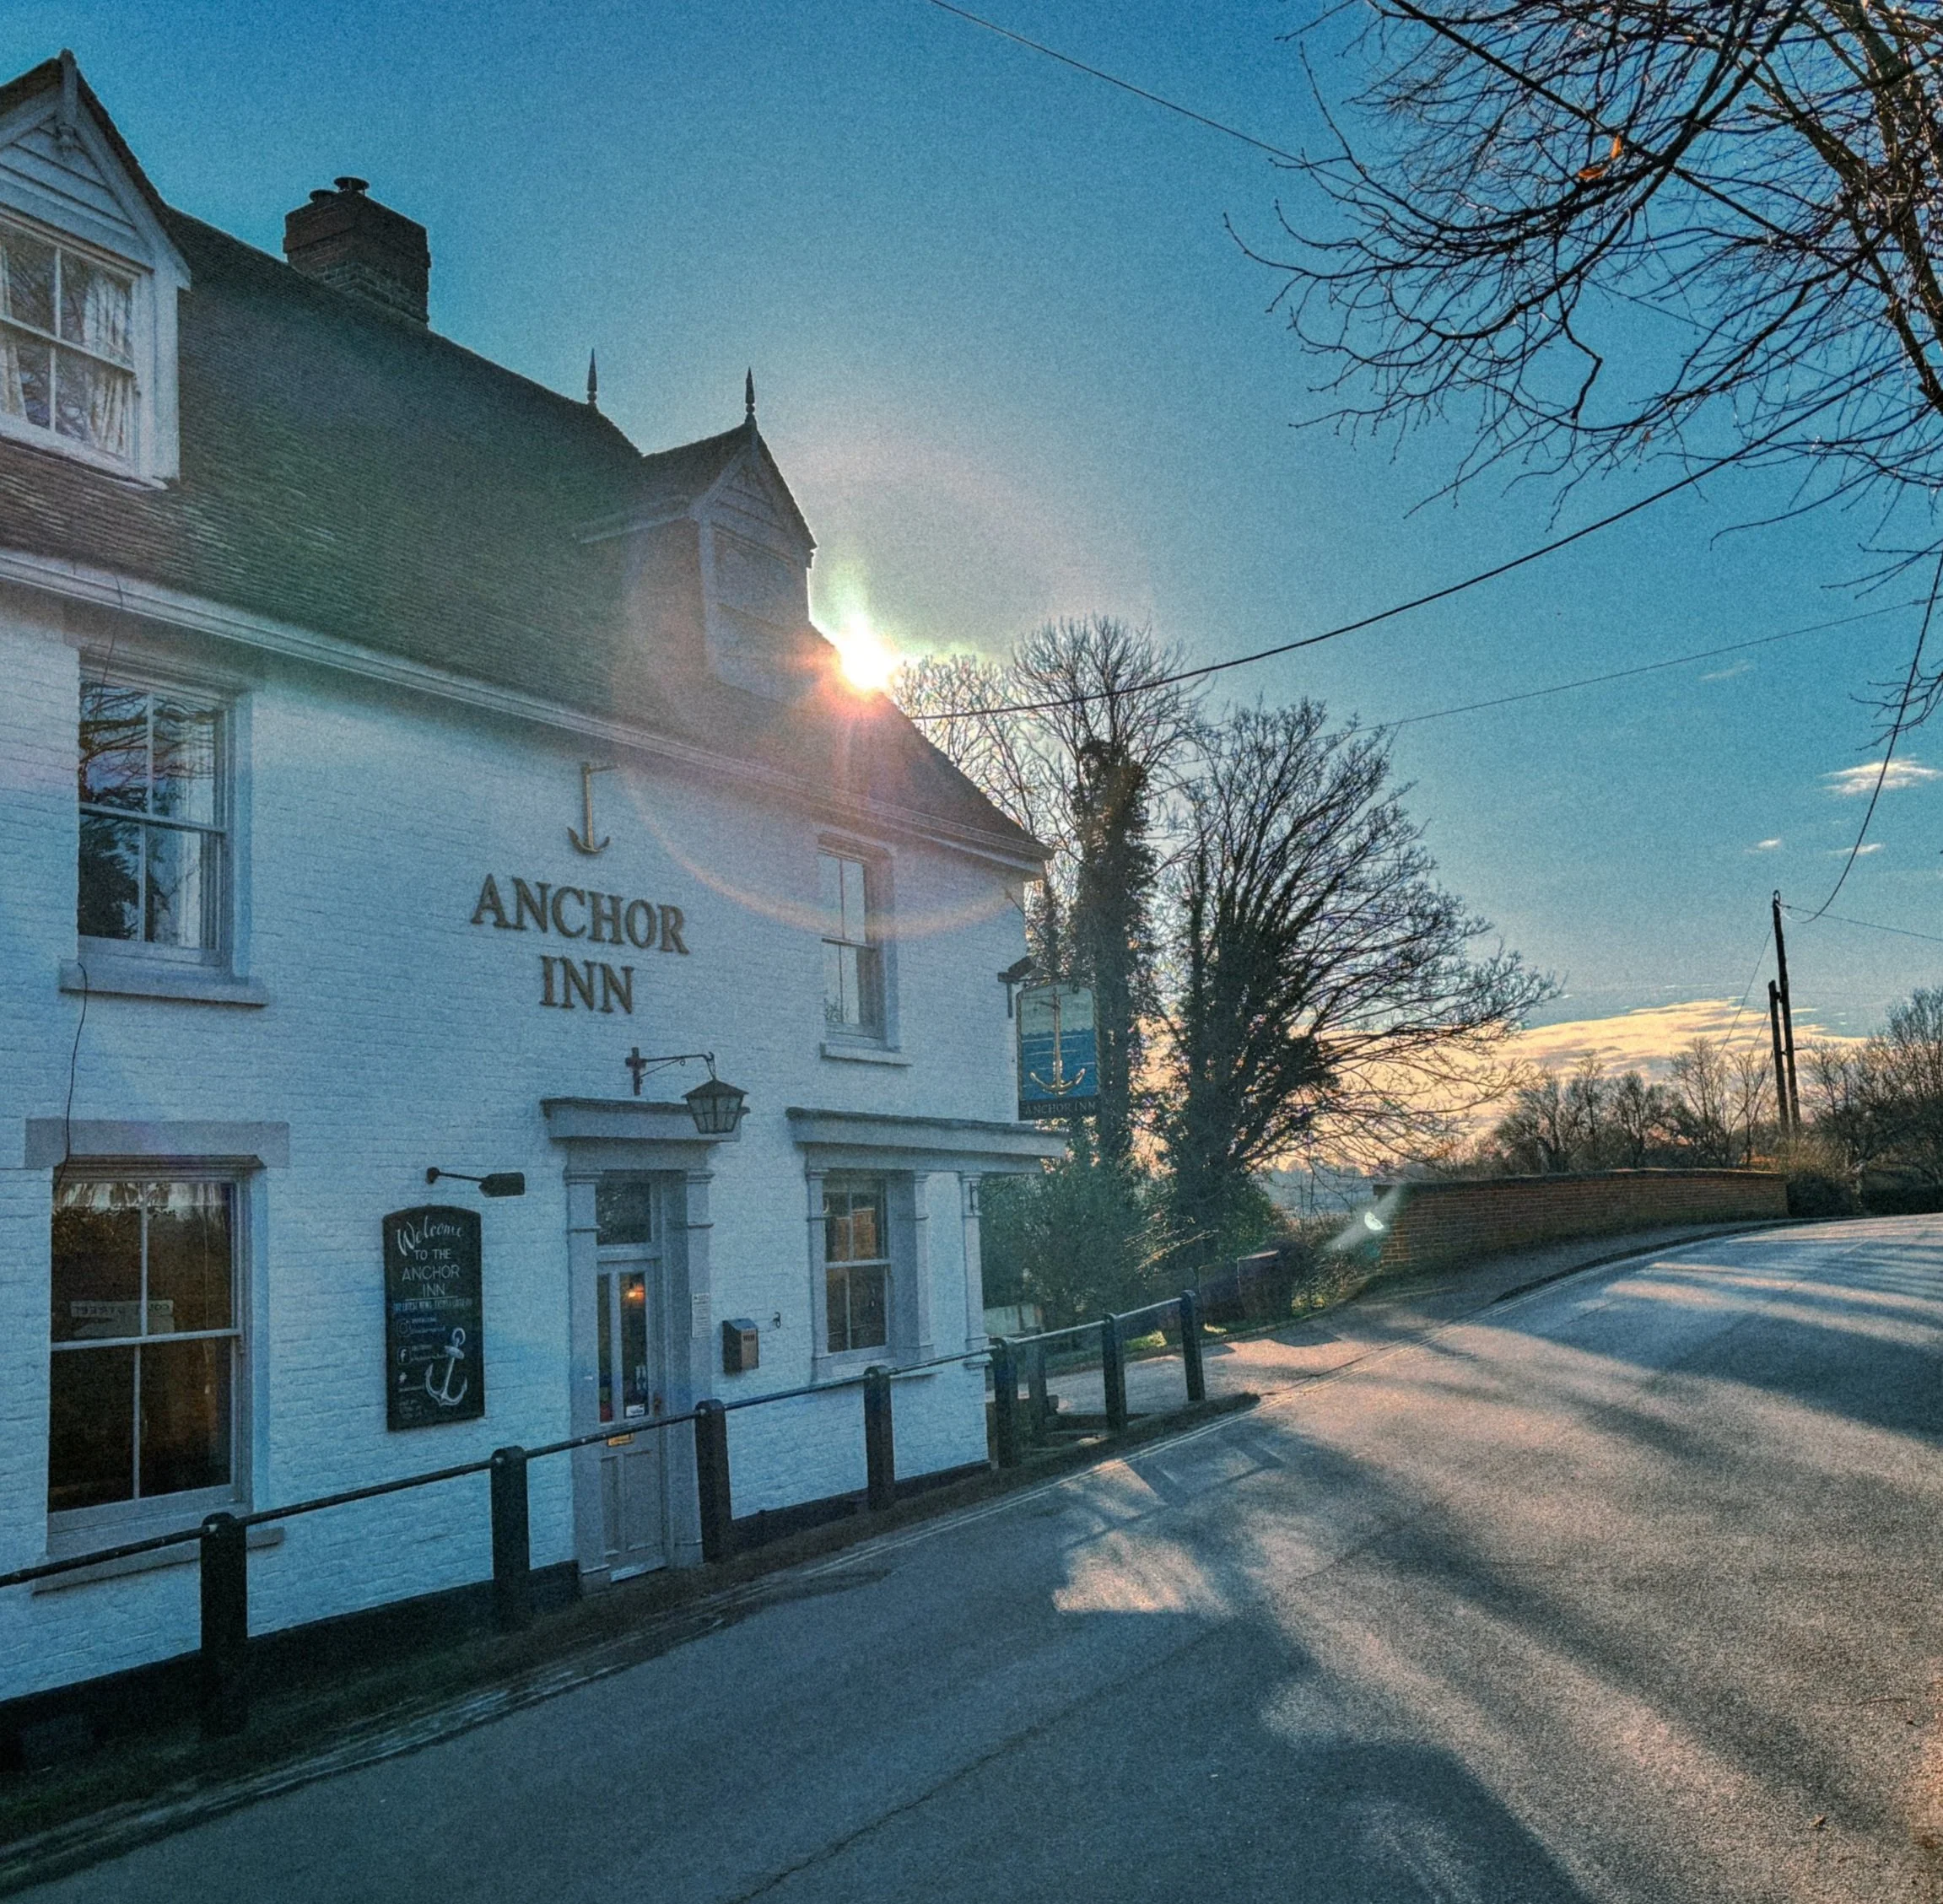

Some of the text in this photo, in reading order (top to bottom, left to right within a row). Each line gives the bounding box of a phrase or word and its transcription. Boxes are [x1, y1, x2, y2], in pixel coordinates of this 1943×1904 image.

[470, 873, 689, 954] ANCHOR
[539, 955, 634, 1014] INN
[1025, 1100, 1096, 1114] ANCHOR INN
[396, 1216, 461, 1256] Welcome
[413, 1249, 451, 1260] TO THE
[402, 1265, 460, 1281] ANCHOR
[423, 1283, 445, 1297] INN
